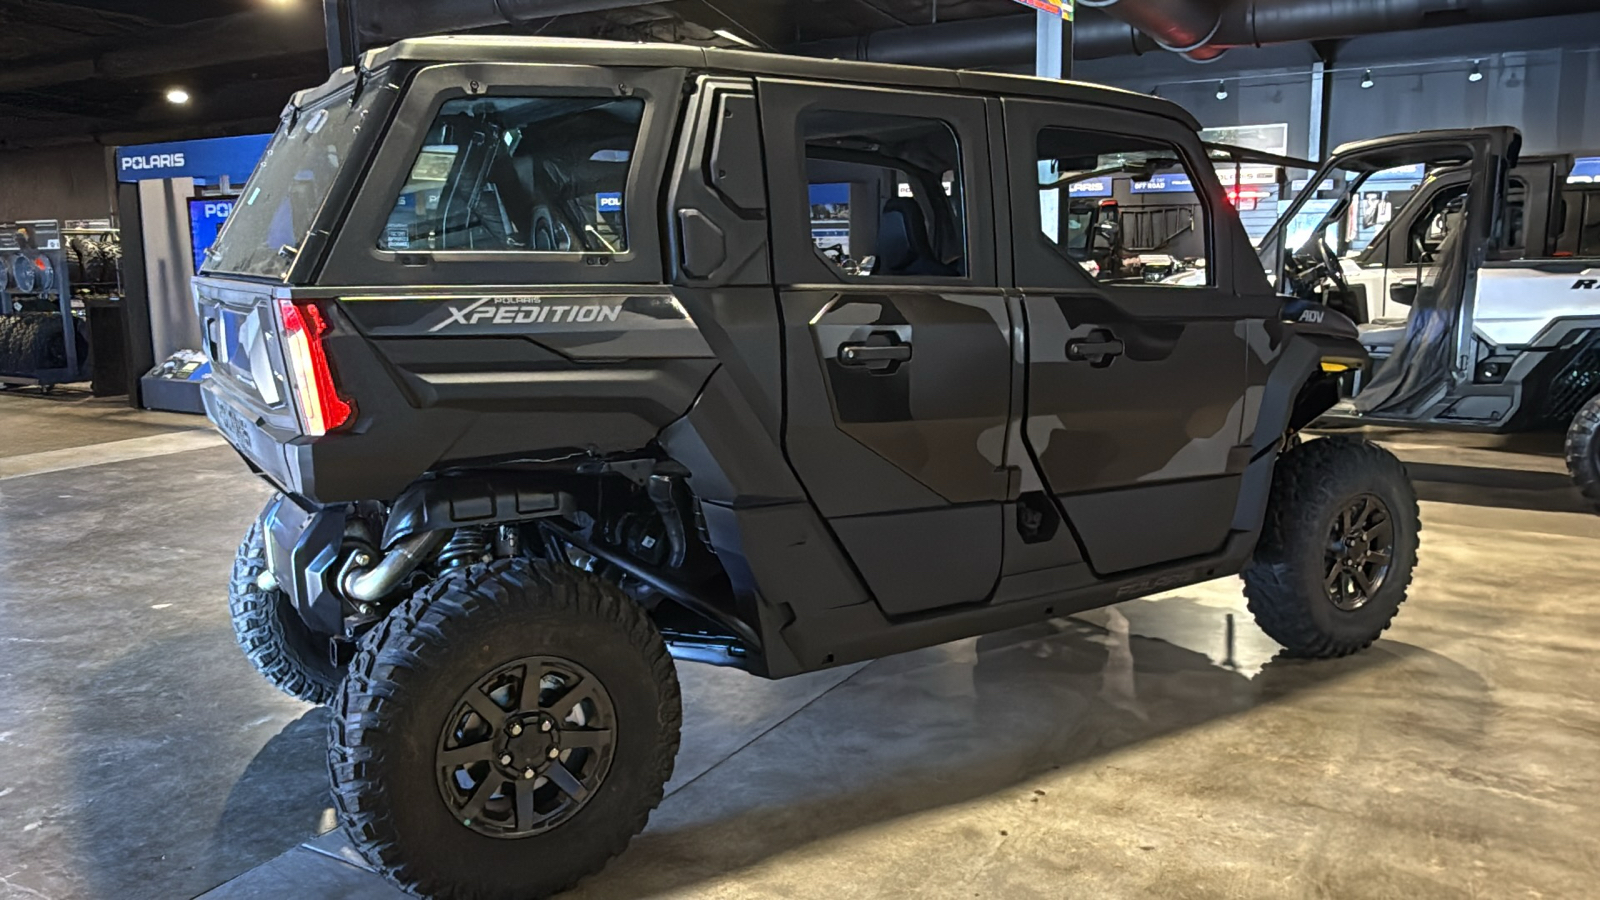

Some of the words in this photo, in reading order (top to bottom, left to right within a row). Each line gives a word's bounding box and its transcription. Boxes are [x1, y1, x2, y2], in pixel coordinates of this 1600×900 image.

[121, 153, 185, 170] POLARIS
[428, 297, 623, 332] XPEDITION
[1299, 309, 1325, 323] ADV
